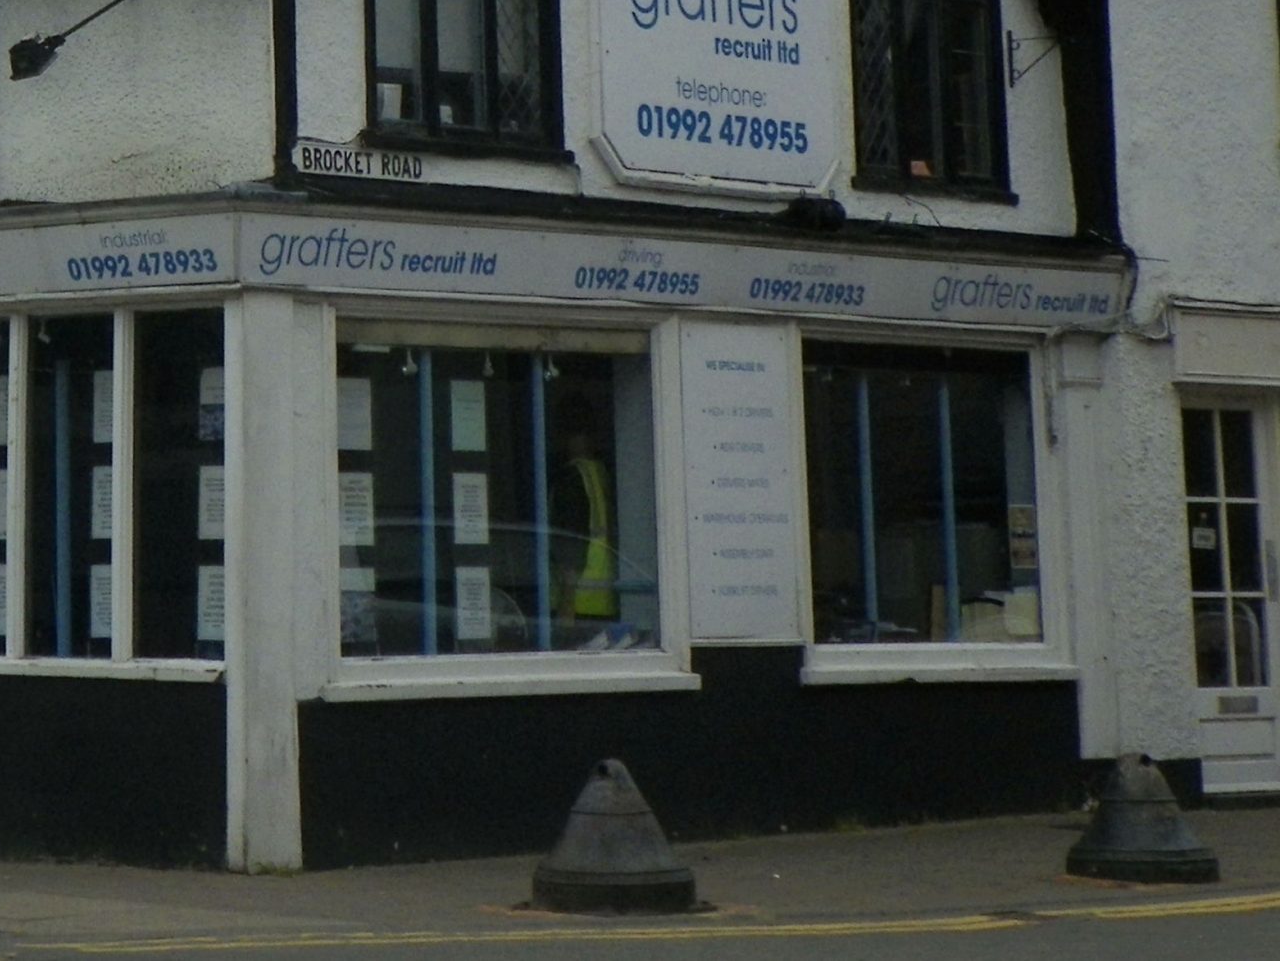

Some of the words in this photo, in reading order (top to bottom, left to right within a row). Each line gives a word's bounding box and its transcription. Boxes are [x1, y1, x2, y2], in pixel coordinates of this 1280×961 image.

[715, 37, 772, 61] recruit
[777, 41, 800, 65] ltd
[676, 76, 767, 107] telephone:
[637, 103, 712, 144] 01992
[719, 114, 808, 154] 478955
[302, 146, 374, 175] BROCKET
[381, 153, 422, 179] ROAD
[67, 254, 133, 281] 01992
[138, 248, 218, 276] 478933
[260, 227, 397, 276] grafters
[400, 251, 466, 274] recruit
[470, 252, 497, 275] ltd
[574, 266, 629, 290] 01992
[633, 270, 700, 295] 478955
[750, 277, 802, 302] 01992
[805, 282, 865, 306] 478933
[931, 273, 1033, 312] grafters
[1035, 293, 1086, 313] recruit
[1088, 294, 1110, 315] ltd
